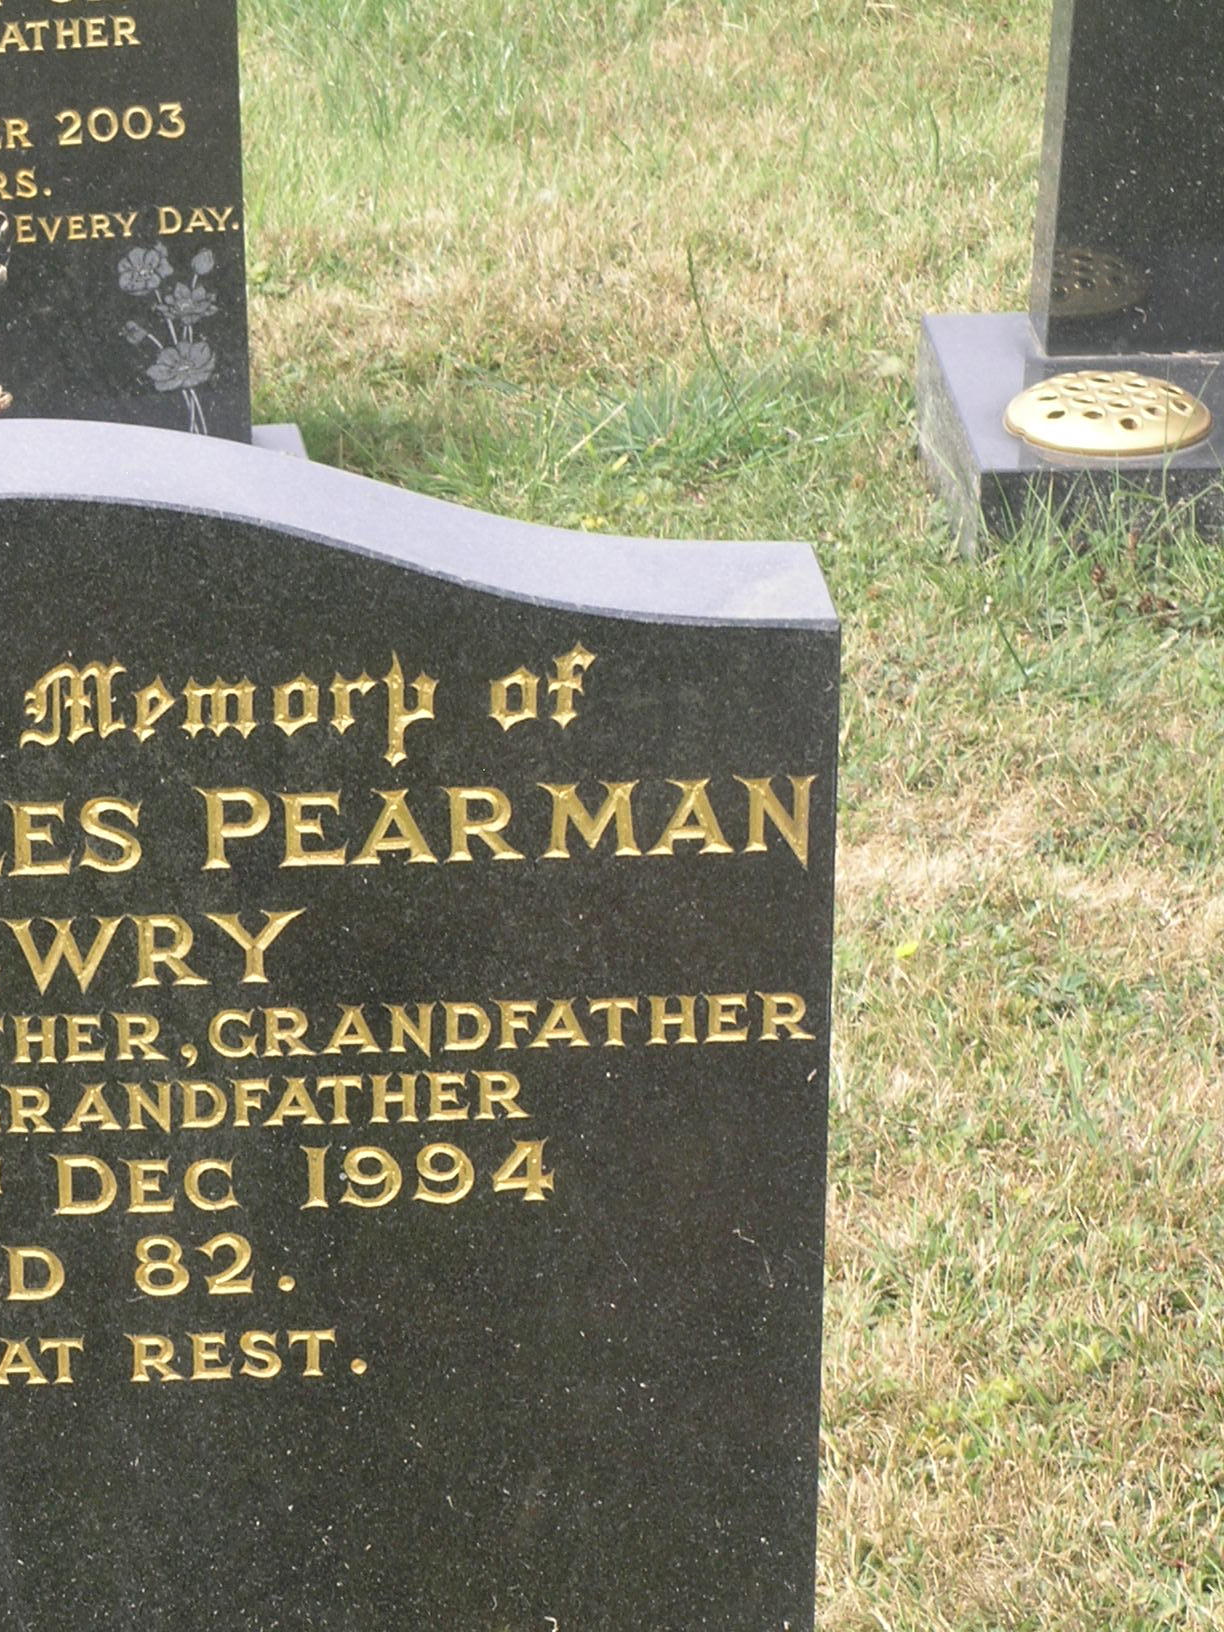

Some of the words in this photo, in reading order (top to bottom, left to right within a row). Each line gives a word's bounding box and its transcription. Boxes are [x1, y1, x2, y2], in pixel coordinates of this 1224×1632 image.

[54, 100, 187, 147] 2003
[13, 210, 139, 245] EVERY
[157, 204, 241, 236] DAY.
[18, 650, 439, 769] Memory
[487, 641, 598, 733] of
[193, 773, 817, 872] PEARMAN
[207, 990, 817, 1060] GRANDFATHER
[50, 1153, 242, 1217] DEC
[299, 1138, 556, 1211] 1994
[133, 1231, 297, 1298] 82.
[124, 1327, 369, 1384] REST.
